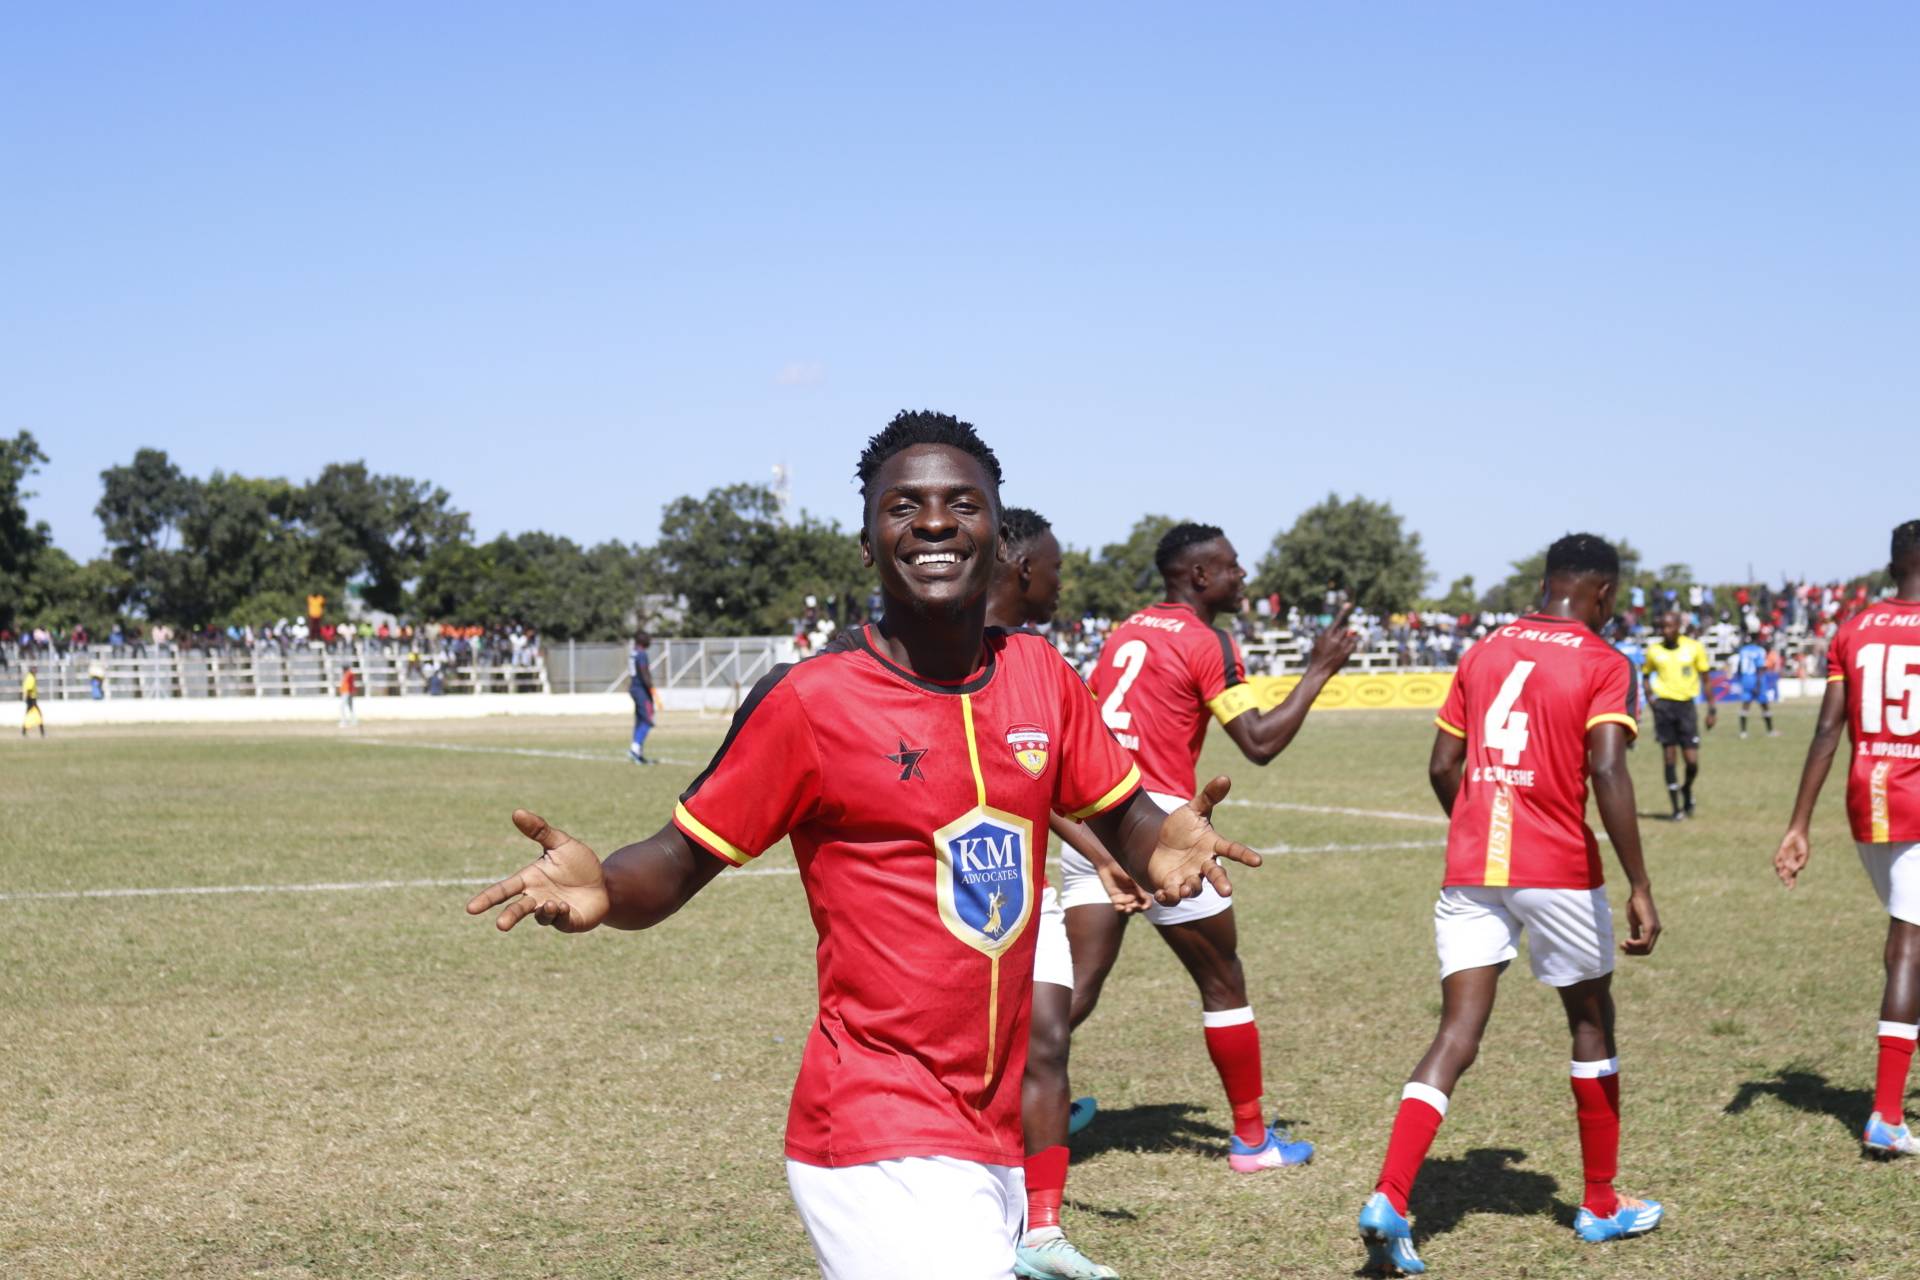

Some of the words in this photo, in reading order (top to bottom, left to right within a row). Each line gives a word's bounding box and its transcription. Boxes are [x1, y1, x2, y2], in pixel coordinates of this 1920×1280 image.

[1518, 629, 1584, 648] MUZA
[1101, 639, 1148, 730] 2
[1483, 660, 1536, 766] 4
[1855, 642, 1920, 736] 15
[956, 834, 1016, 872] KM
[961, 868, 1018, 885] ADVOCATES
